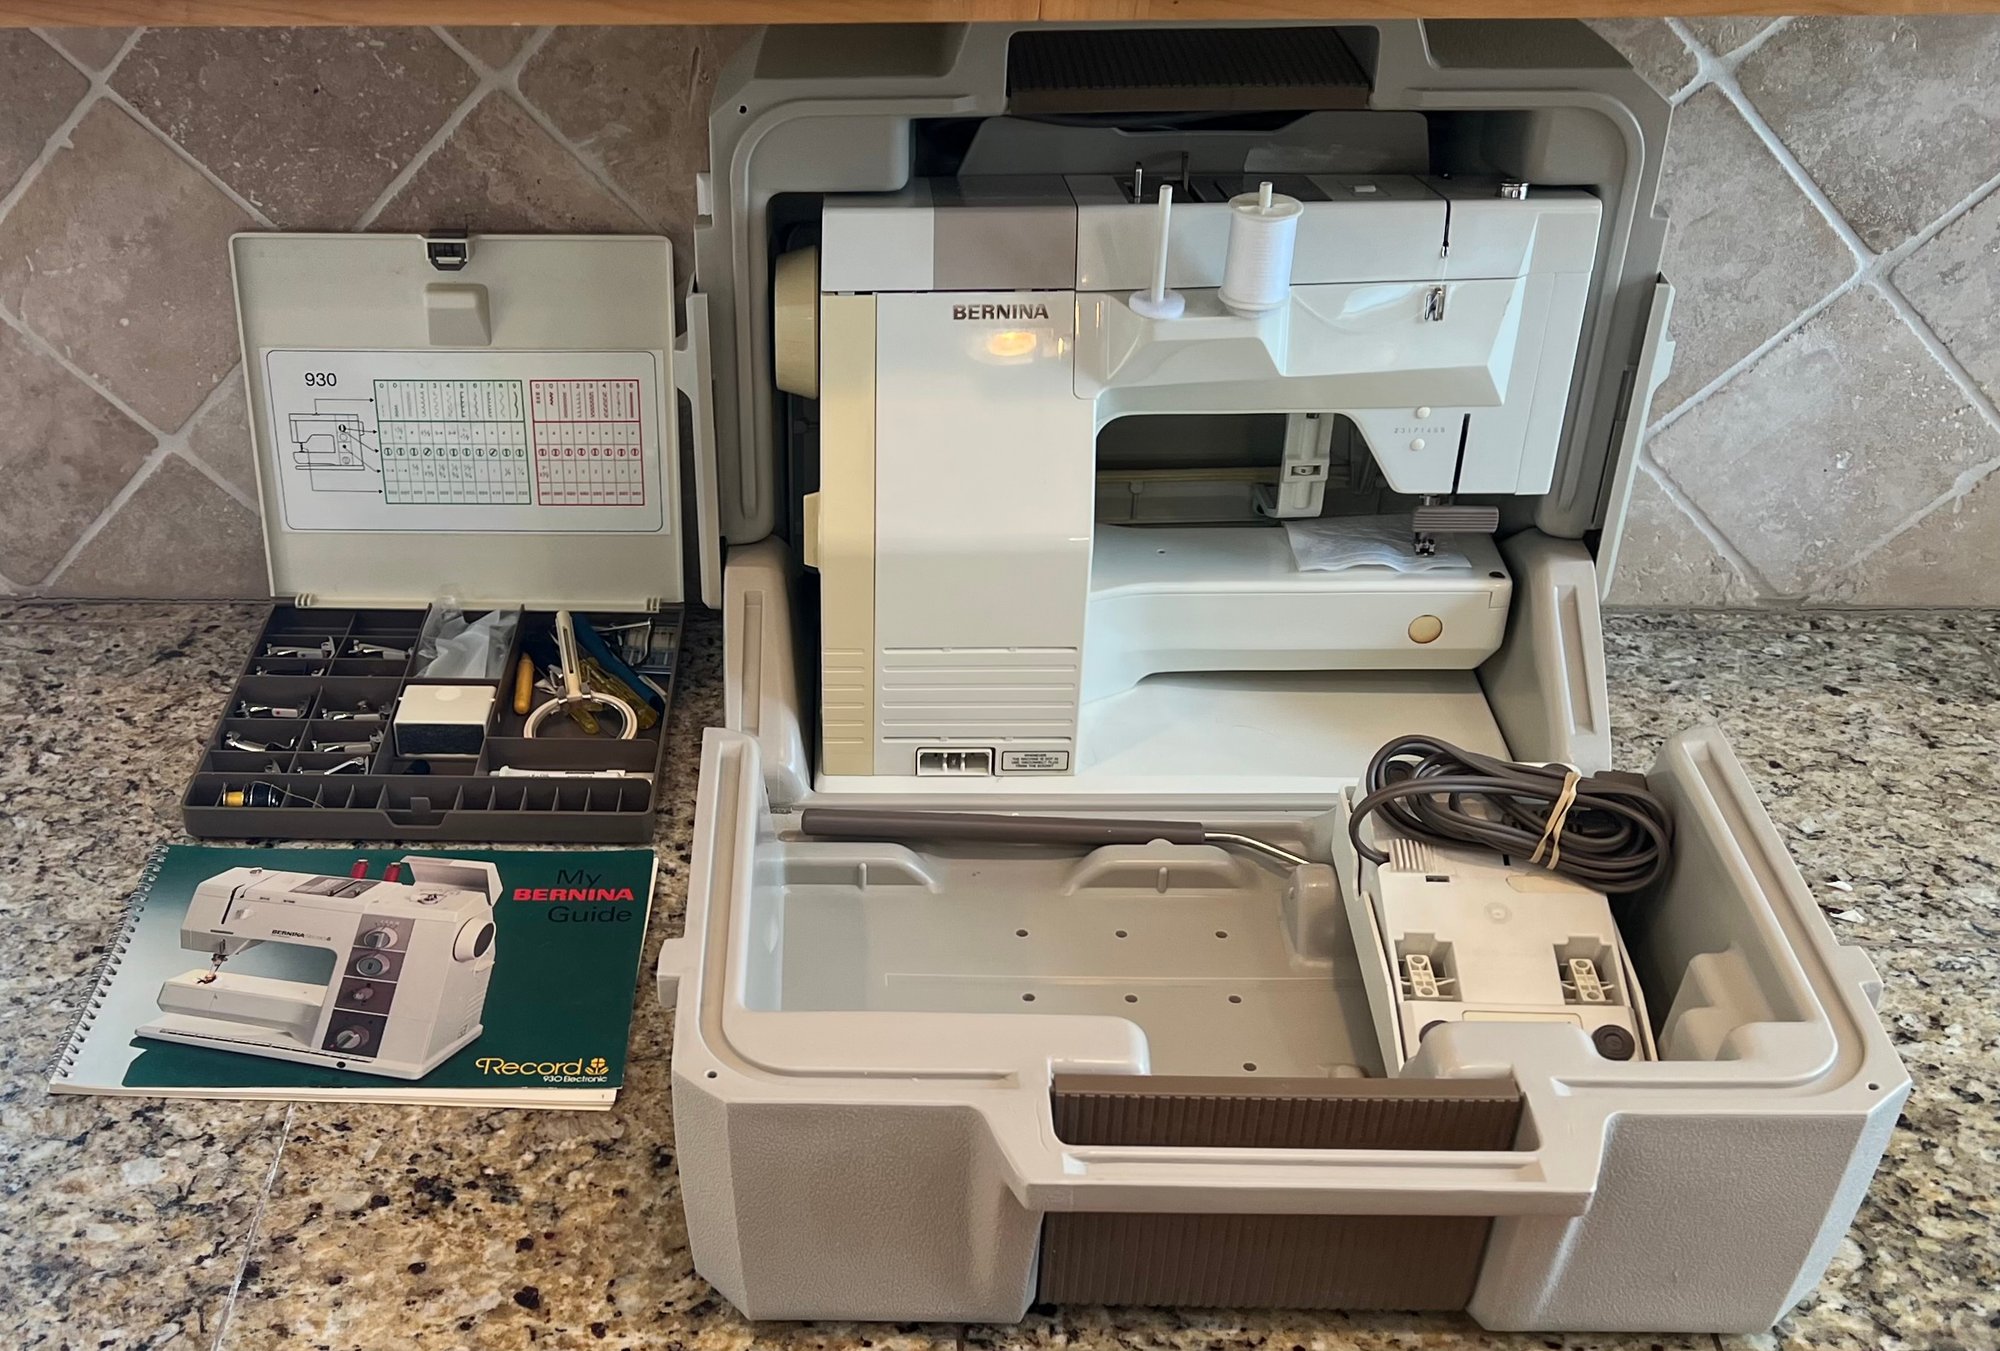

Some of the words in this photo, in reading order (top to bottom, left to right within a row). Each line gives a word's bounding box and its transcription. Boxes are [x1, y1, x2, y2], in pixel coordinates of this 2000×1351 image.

[953, 304, 1049, 320] BERNINA
[305, 372, 337, 387] 930
[557, 869, 602, 888] My
[512, 888, 634, 902] BERNINA
[547, 905, 633, 923] Guide
[475, 1057, 583, 1076] Record
[542, 1075, 563, 1083] 930
[563, 1075, 608, 1083] Electronic
